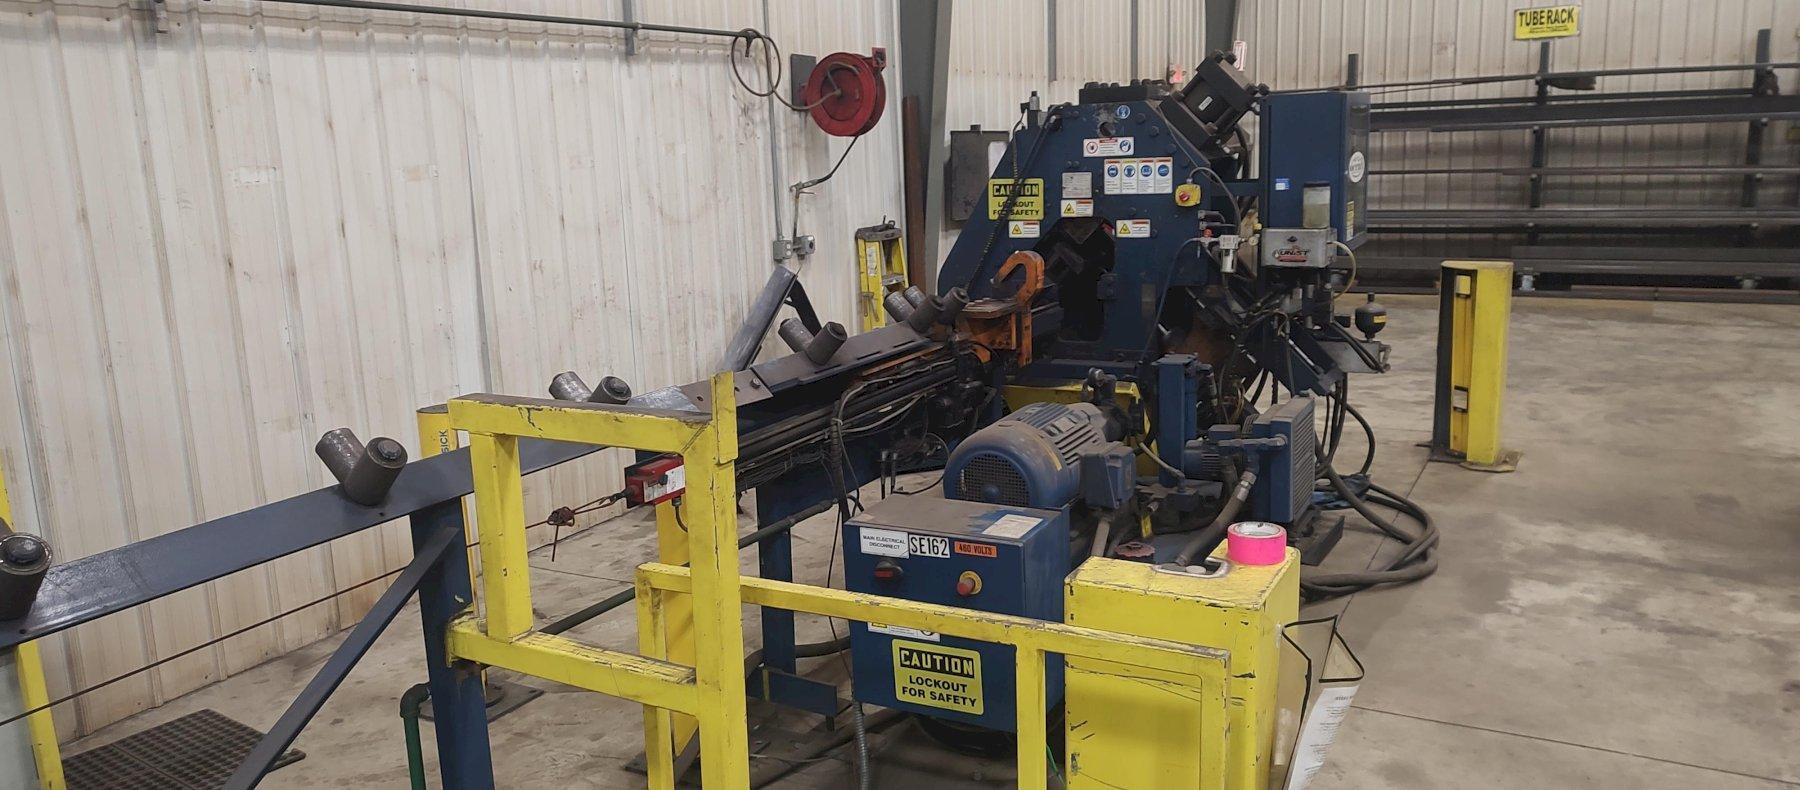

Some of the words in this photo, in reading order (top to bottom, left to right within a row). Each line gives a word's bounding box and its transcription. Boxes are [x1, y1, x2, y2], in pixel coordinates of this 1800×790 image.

[1519, 10, 1545, 26] TUBE
[1547, 7, 1574, 25] RACK
[876, 536, 905, 544] ELECTRICAL
[910, 536, 949, 556] SE162
[959, 543, 971, 552] 460
[973, 545, 993, 555] VOLTS
[900, 650, 973, 676] CAUTION
[909, 675, 967, 693] LOCKOUT
[902, 686, 925, 698] FOR
[930, 691, 976, 707] SAFETY
